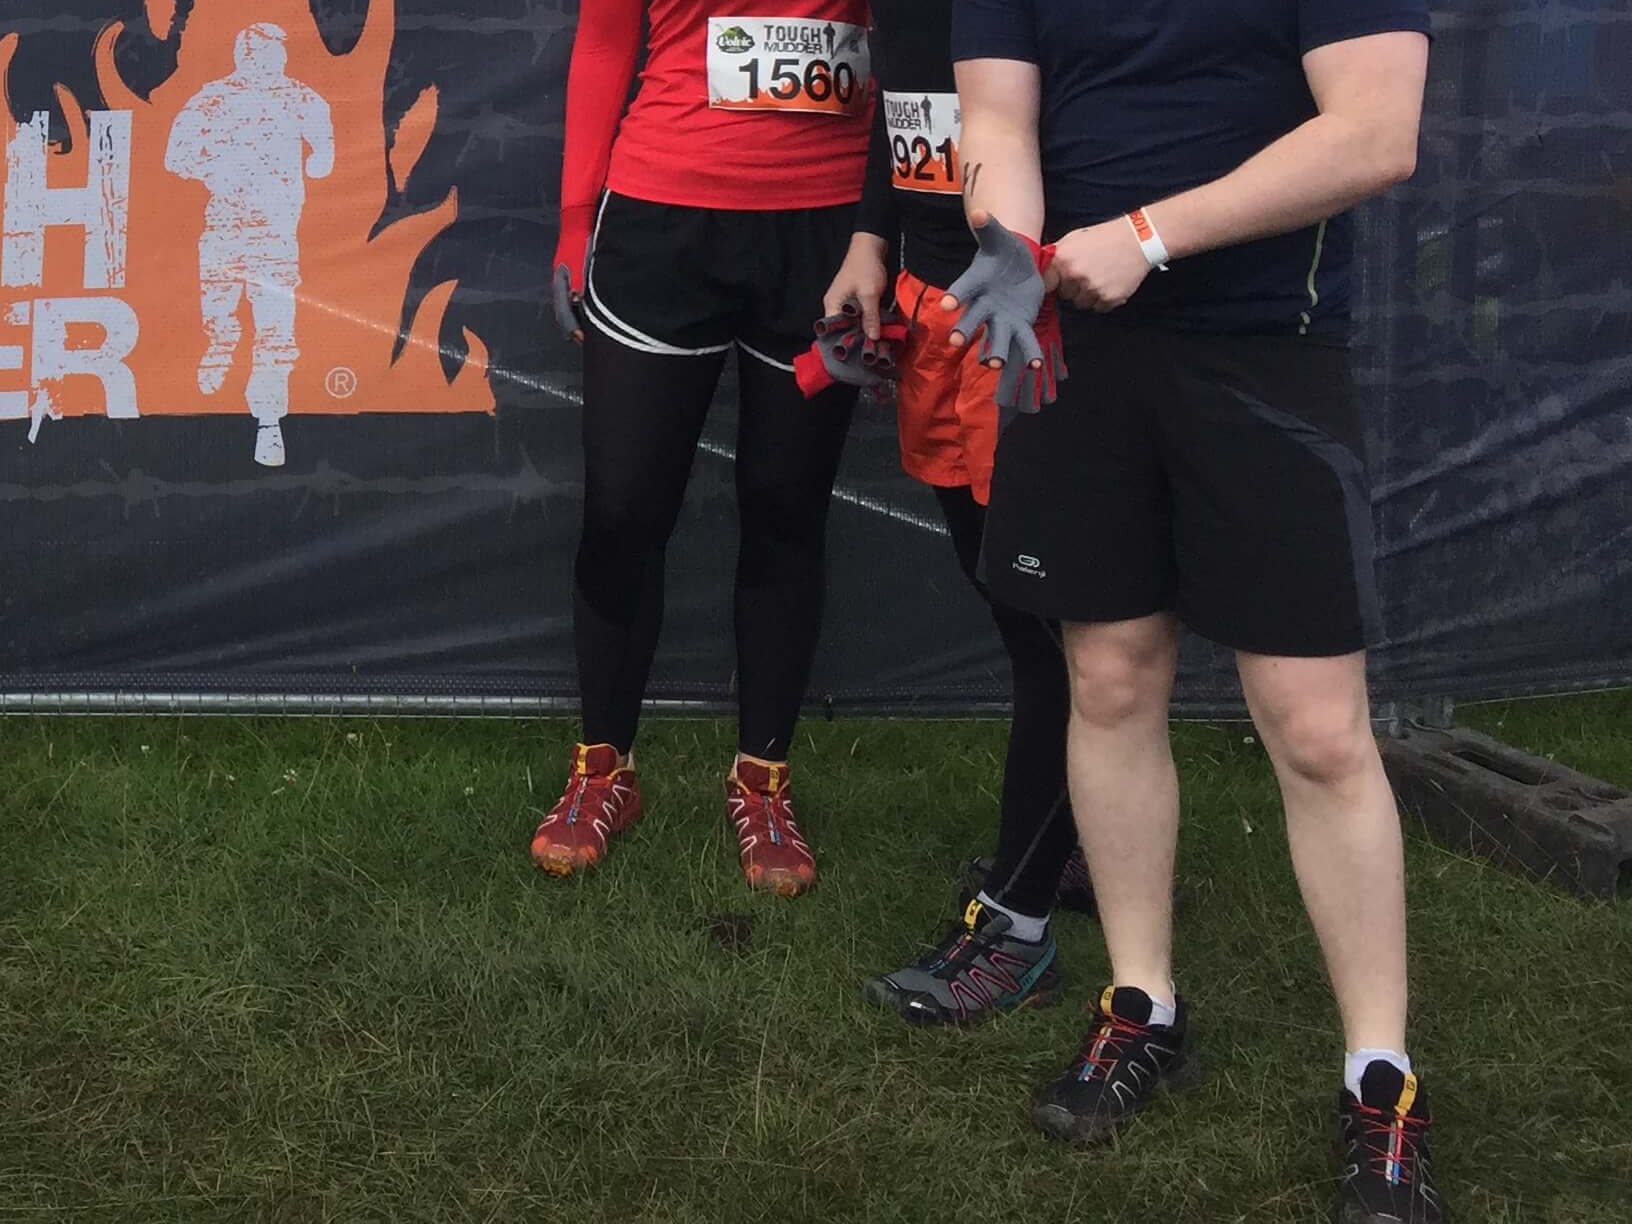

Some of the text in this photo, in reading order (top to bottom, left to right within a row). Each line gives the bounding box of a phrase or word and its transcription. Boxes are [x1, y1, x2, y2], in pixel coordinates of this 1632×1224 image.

[763, 24, 822, 43] TOUGH
[763, 41, 823, 55] MUDDER
[738, 57, 855, 105] 1560
[889, 134, 955, 183] 921
